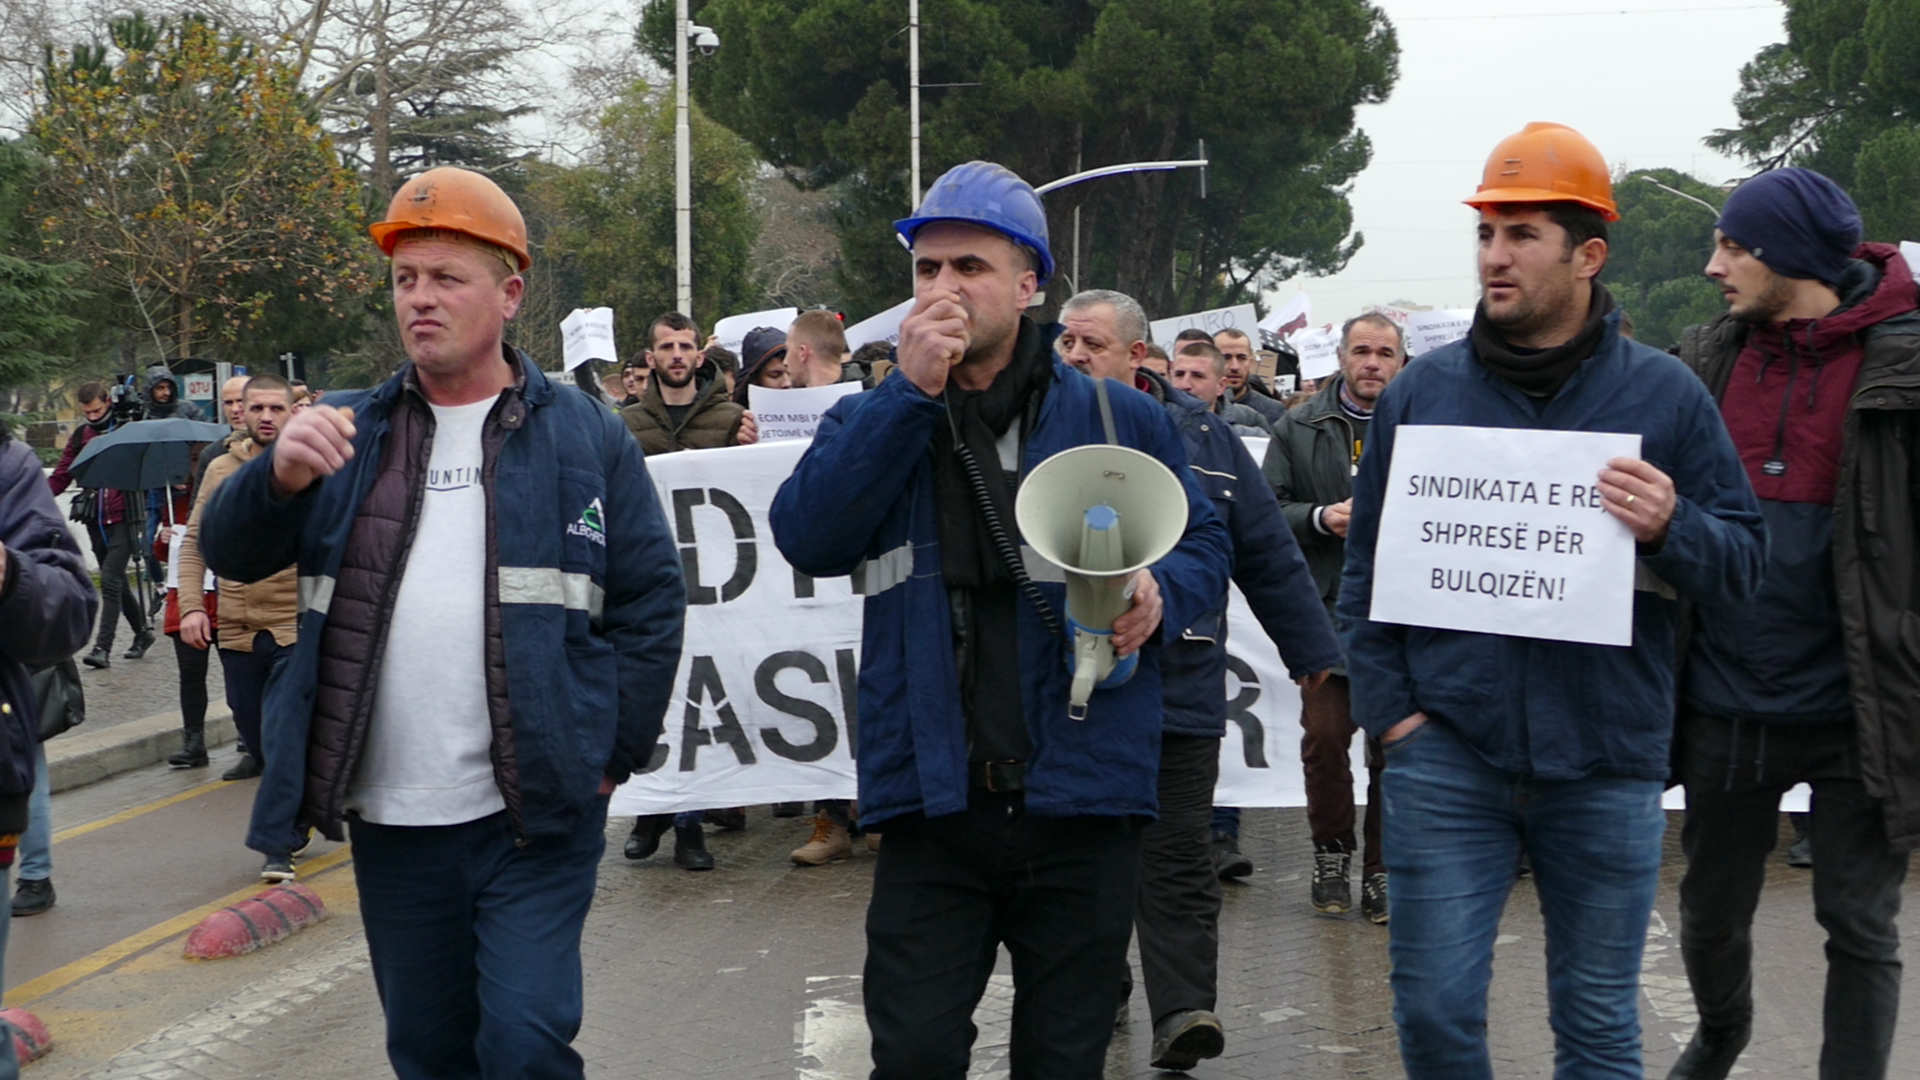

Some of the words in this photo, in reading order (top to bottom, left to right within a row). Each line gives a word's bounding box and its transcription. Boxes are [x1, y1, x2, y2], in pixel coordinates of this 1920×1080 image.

[189, 381, 210, 395] QTU
[758, 413, 785, 423] ECIM
[787, 413, 809, 423] MBI
[1407, 474, 1538, 505] SINDIKATA
[1549, 483, 1562, 506] E
[1420, 520, 1529, 551] SHPRESË
[1536, 523, 1584, 555] PËR
[1430, 567, 1566, 601] BULQIZËN!
